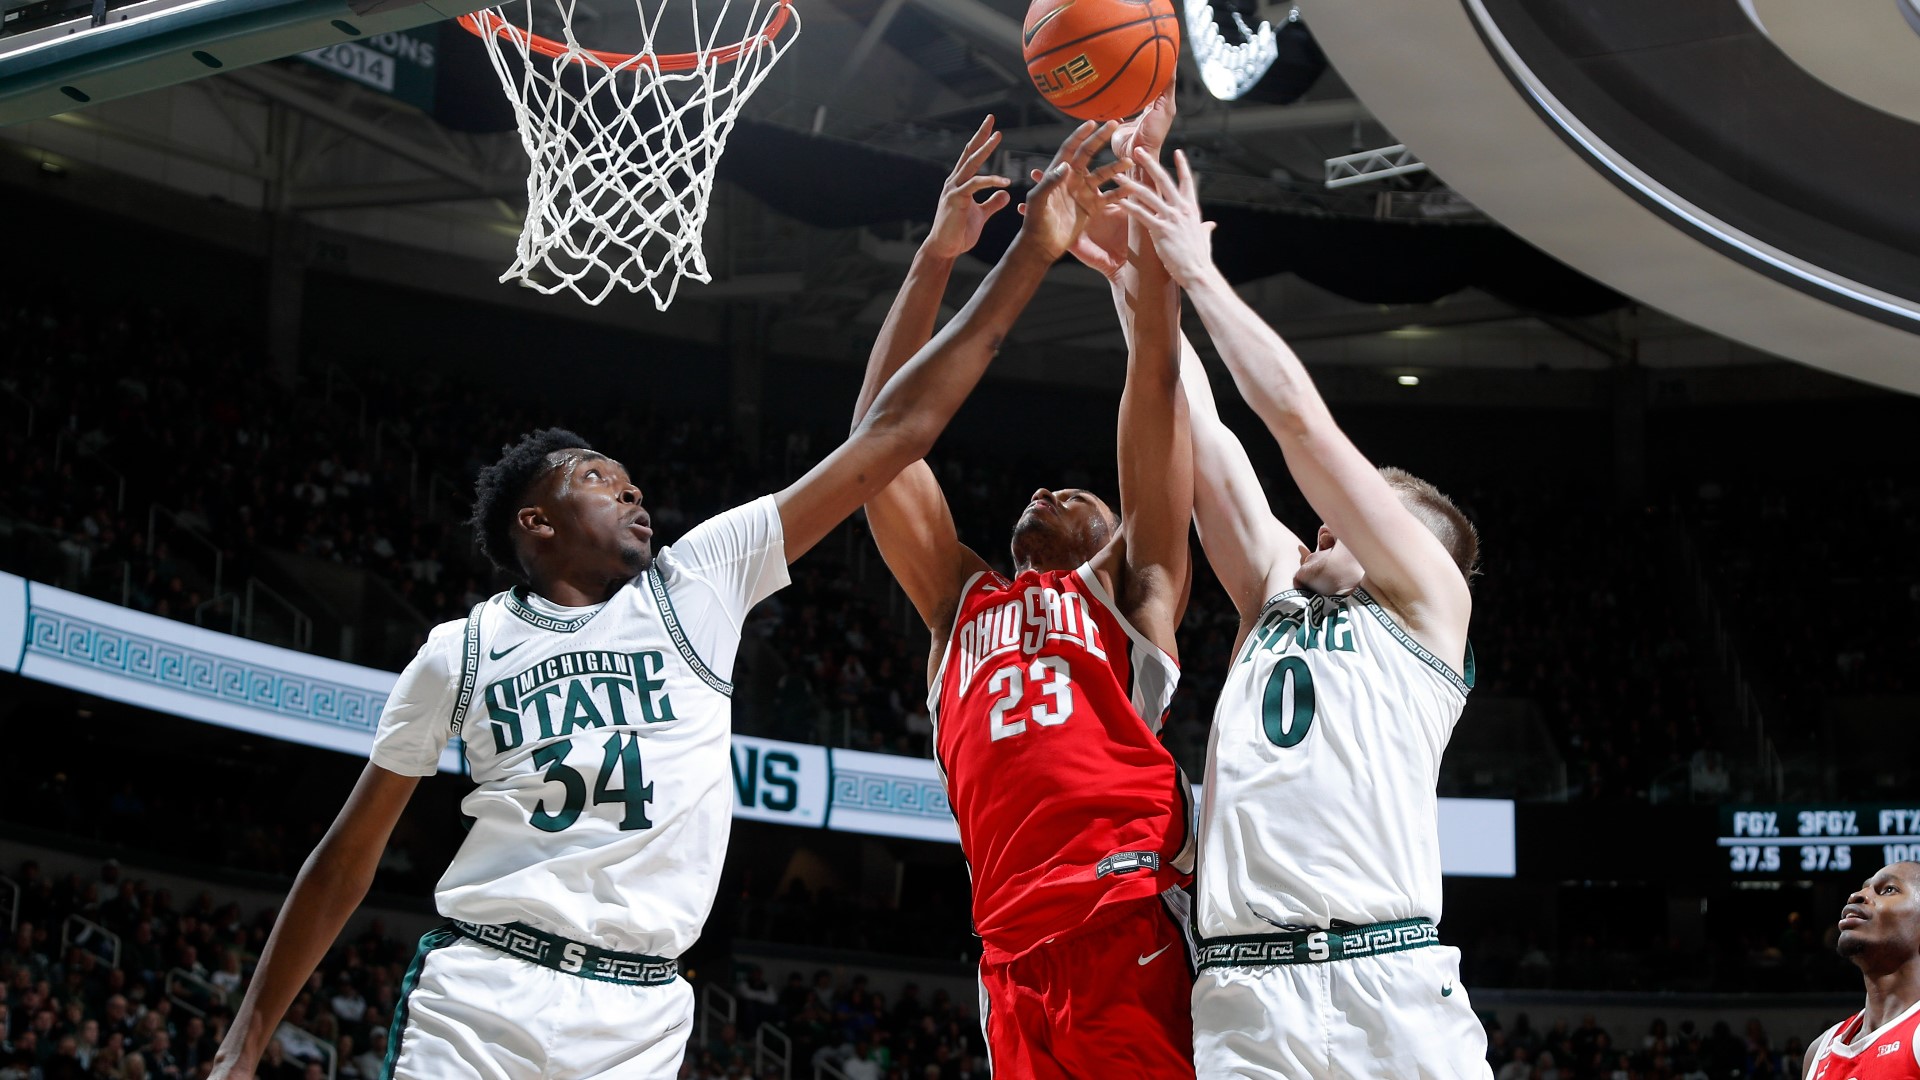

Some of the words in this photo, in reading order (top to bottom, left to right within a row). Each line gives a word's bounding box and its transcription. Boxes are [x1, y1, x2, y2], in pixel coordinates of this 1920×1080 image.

[959, 600, 1024, 698] OHIO
[1023, 586, 1108, 662] SATE
[518, 652, 631, 695] MICHIGAN
[484, 650, 678, 755] STATE
[988, 655, 1073, 742] 23
[1262, 656, 1316, 748] 0
[529, 729, 654, 832] 34
[1733, 811, 1780, 837] FG%
[1797, 810, 1860, 836] 3FG%
[1141, 855, 1152, 863] 48
[1729, 846, 1781, 872] 37.5
[1800, 846, 1852, 872] 37.5
[559, 943, 587, 973] S
[1307, 932, 1330, 961] S
